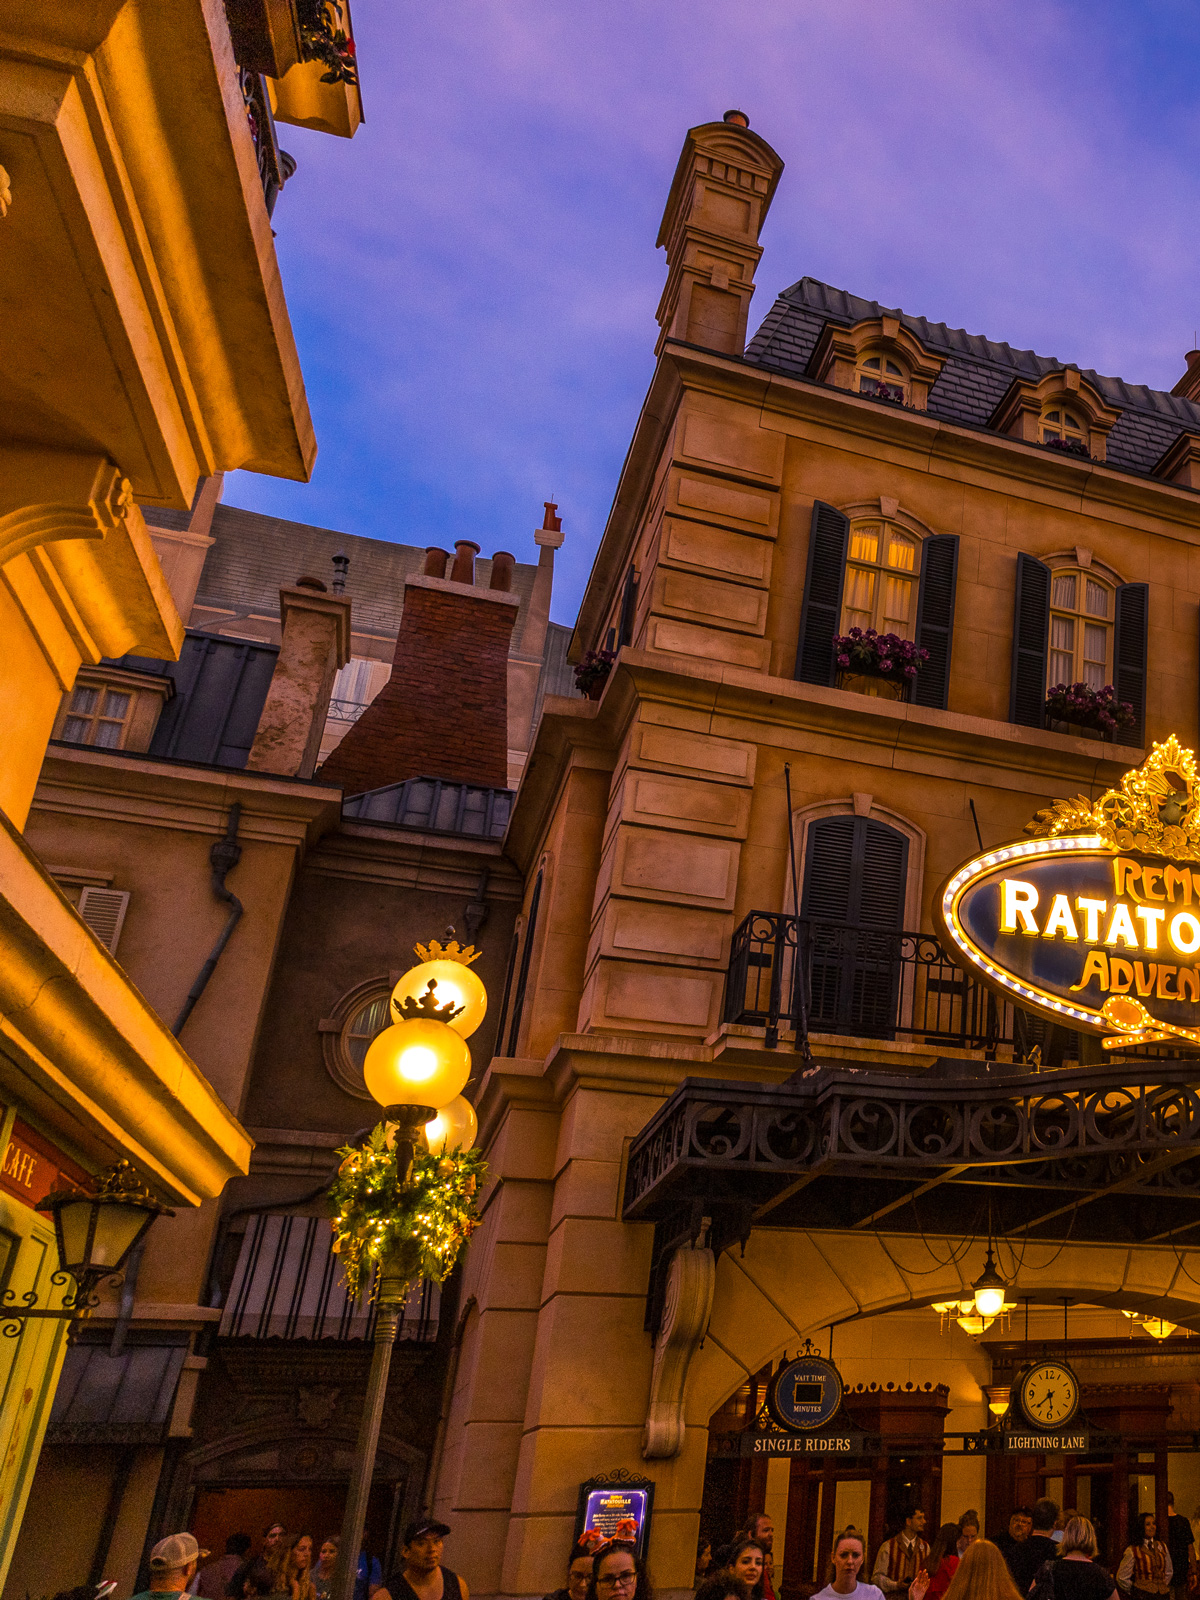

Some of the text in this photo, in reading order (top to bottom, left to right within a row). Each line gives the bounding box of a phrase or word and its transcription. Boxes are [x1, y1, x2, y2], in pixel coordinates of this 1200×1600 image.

[794, 1374, 827, 1382] WAIT TIME
[1045, 1370, 1055, 1380] 12
[1028, 1389, 1035, 1400] 9
[1065, 1389, 1071, 1400] 3
[793, 1405, 822, 1413] MINUTES
[1046, 1409, 1053, 1420] 6
[754, 1438, 851, 1452] SINGLE RIDERS
[1008, 1437, 1085, 1449] LIGHTNING LANE
